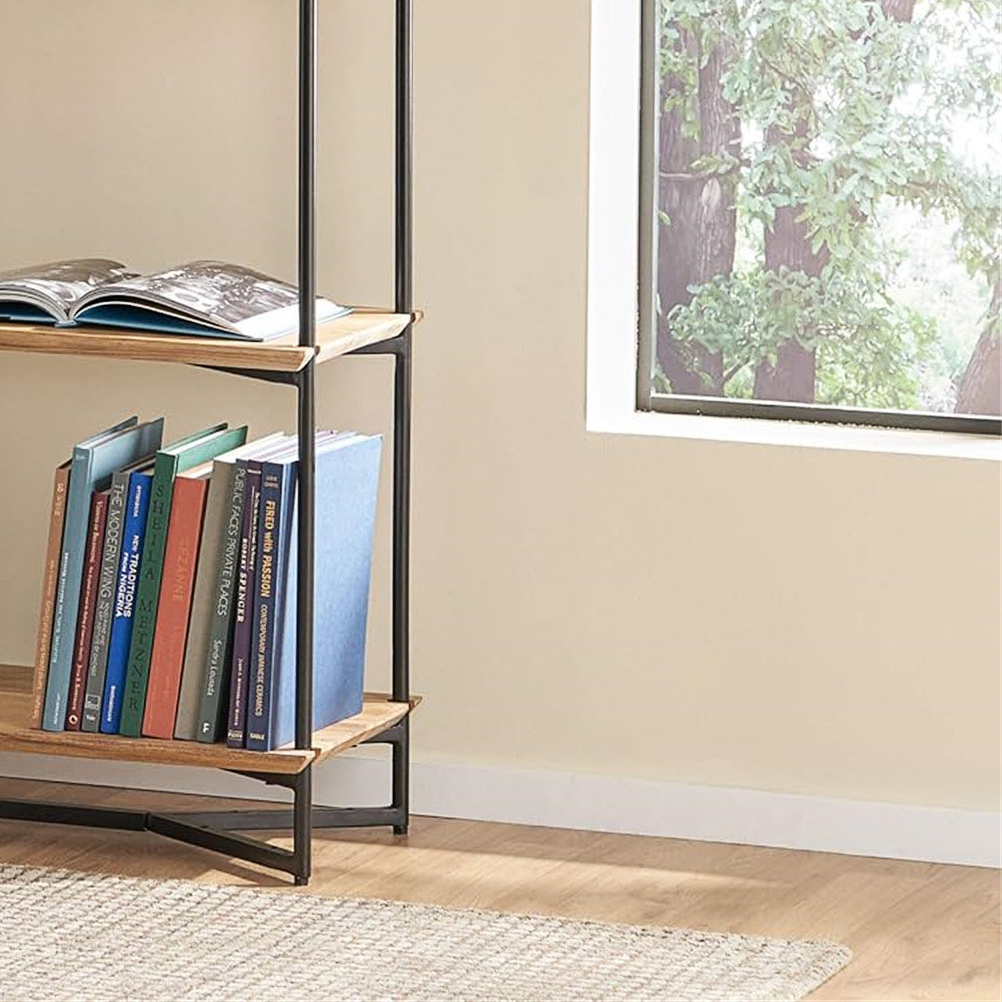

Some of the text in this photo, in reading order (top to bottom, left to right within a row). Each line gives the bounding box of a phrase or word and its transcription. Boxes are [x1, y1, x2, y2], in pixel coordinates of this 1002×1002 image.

[99, 484, 124, 598] THE MODERN WING
[217, 467, 245, 616] PUBLIC FACES PRIVATE PLACES
[262, 530, 273, 553] with
[265, 500, 275, 530] FIRED
[115, 551, 129, 618] FROM NIGERIA
[123, 552, 139, 618] TRADITIONS
[129, 485, 164, 711] SHEILA METZNER
[236, 572, 246, 623] SPENCER
[260, 554, 272, 597] PASSION
[210, 639, 222, 665] Sandra
[254, 603, 267, 716] CONTEMPORARY JAPANESE CERAMICS
